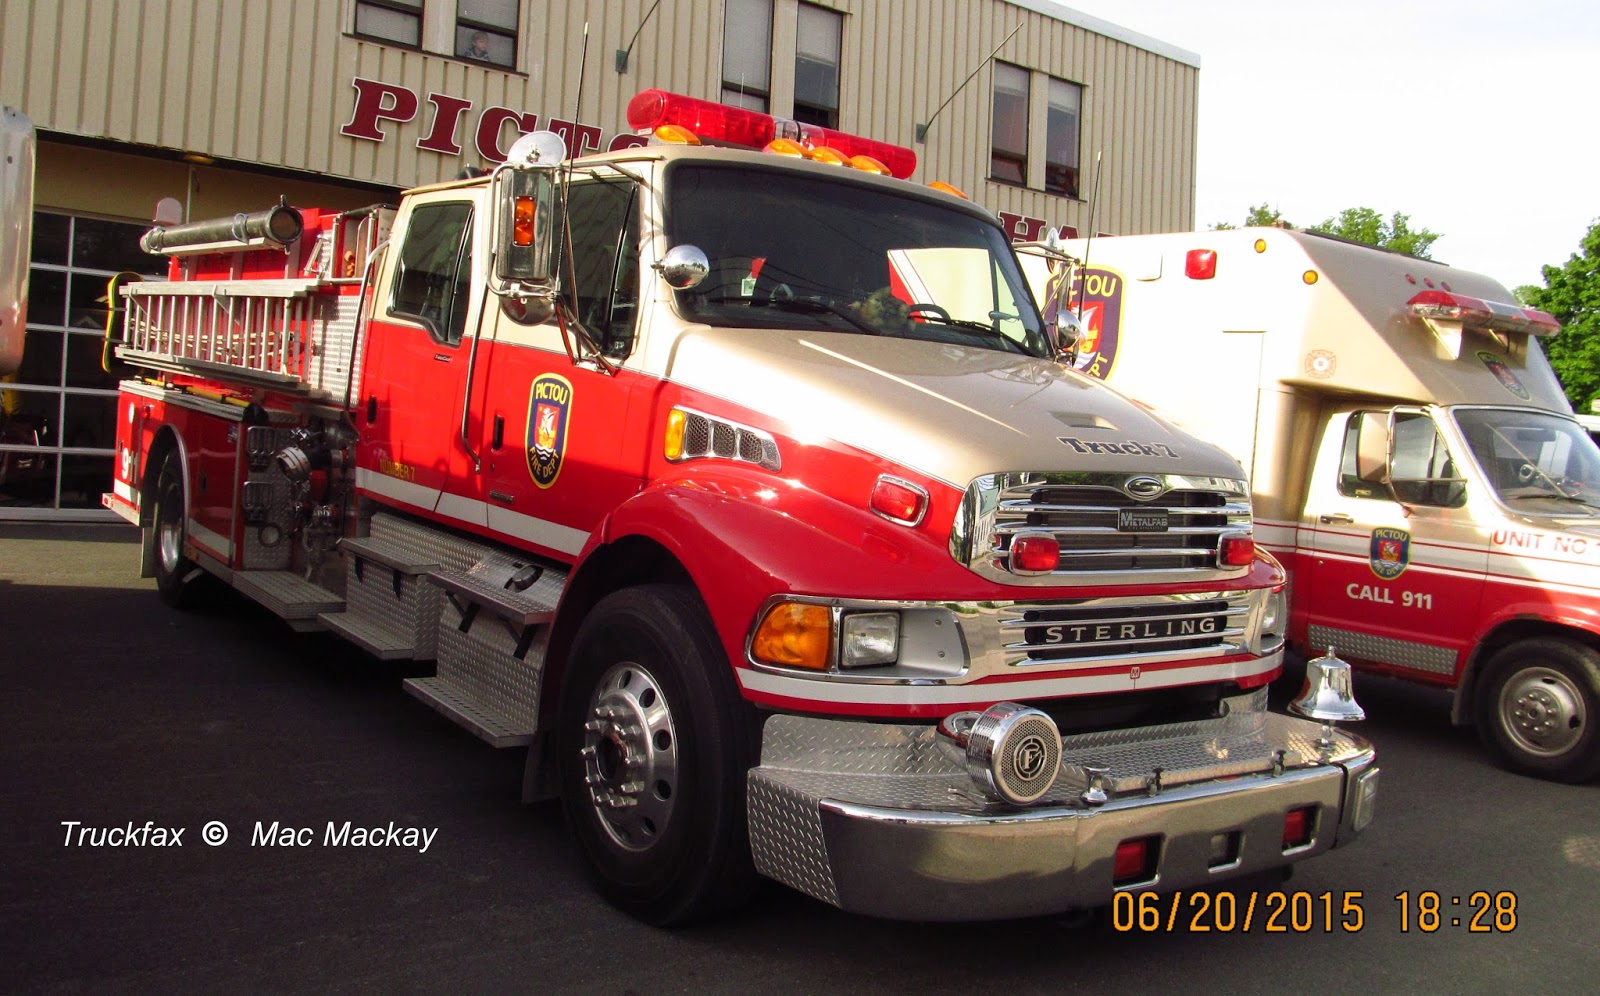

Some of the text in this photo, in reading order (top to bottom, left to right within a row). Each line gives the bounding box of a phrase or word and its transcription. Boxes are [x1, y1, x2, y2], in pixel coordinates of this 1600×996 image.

[535, 382, 568, 405] PICTOU
[1056, 436, 1181, 459] Truck 7
[379, 458, 409, 479] NUMBER
[529, 446, 559, 478] FIRE DEPT
[1120, 511, 1168, 527] METALFAB
[1375, 529, 1408, 541] PICTOU
[1493, 529, 1544, 549] UNIT
[1346, 583, 1433, 610] CALL 911
[1046, 617, 1216, 643] STERLING
